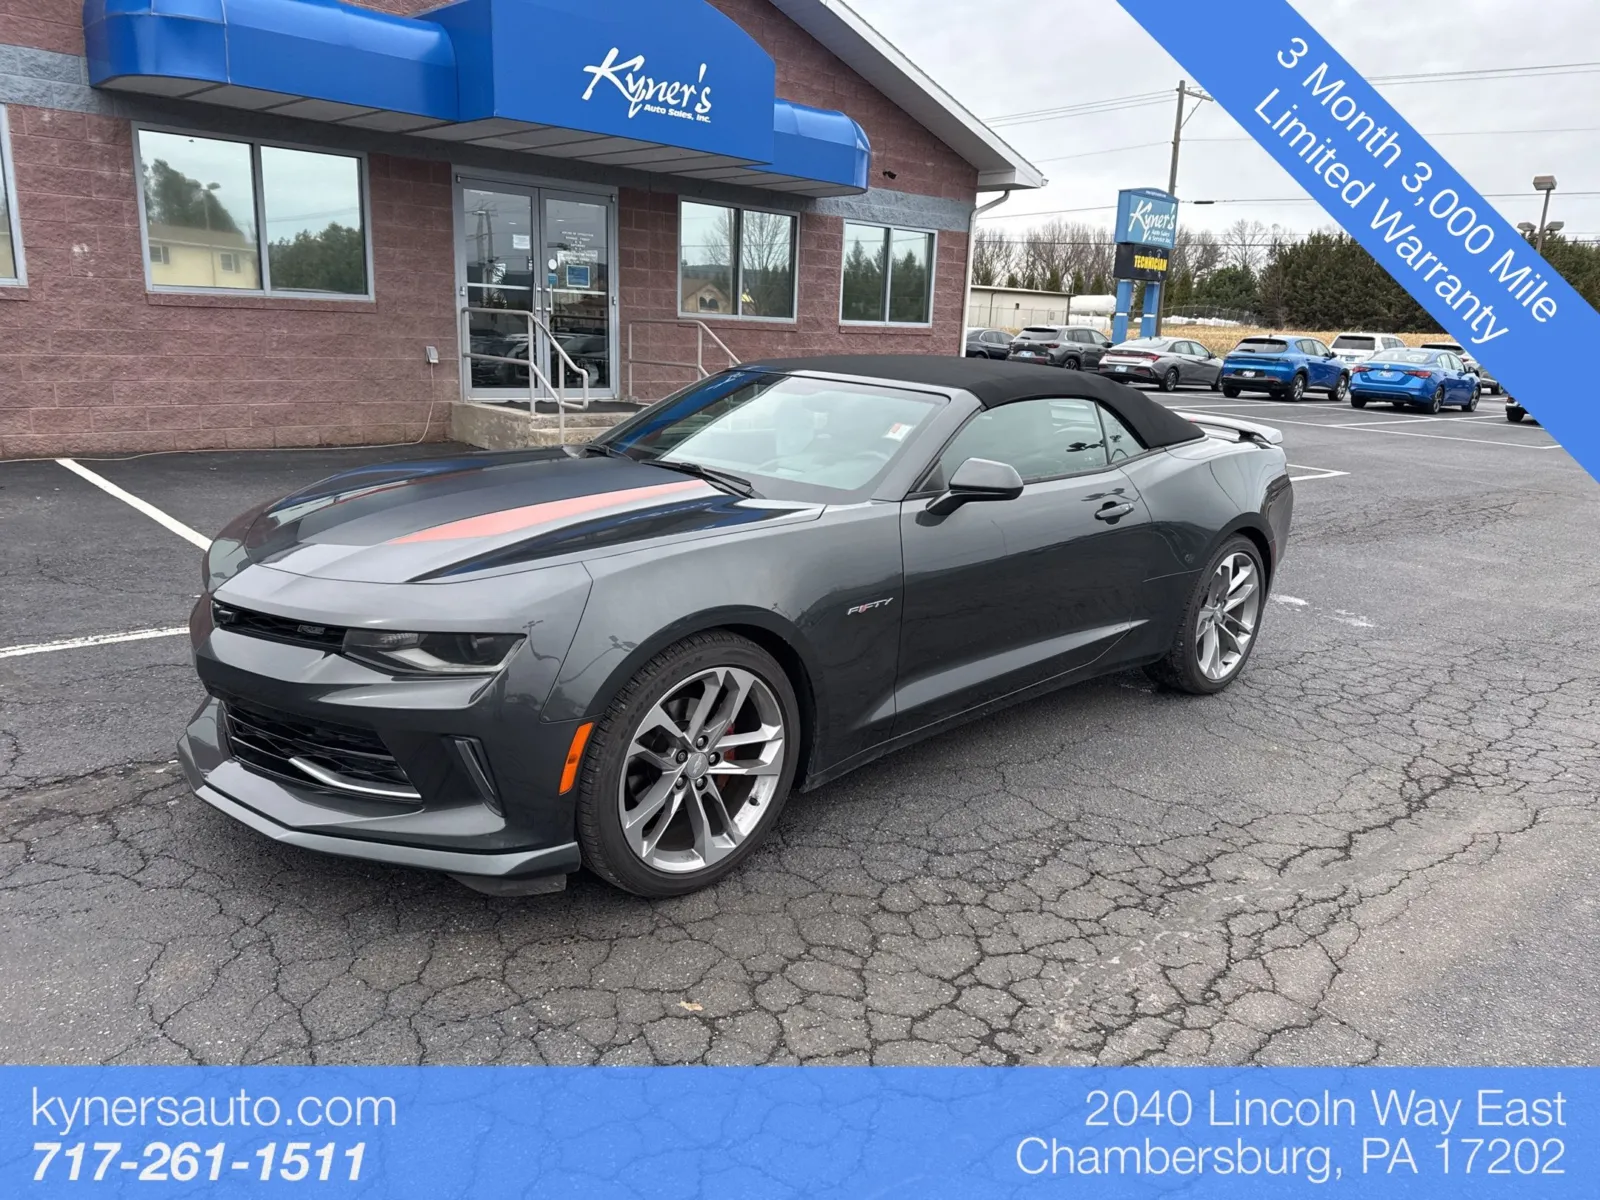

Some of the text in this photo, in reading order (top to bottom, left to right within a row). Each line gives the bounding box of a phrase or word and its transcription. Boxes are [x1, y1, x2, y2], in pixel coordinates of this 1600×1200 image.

[581, 47, 712, 119] Kyner's
[643, 104, 667, 115] Auto
[1128, 200, 1176, 242] Kyner's
[1134, 254, 1168, 271] TECHNICIAN
[847, 597, 894, 615] FIFTY
